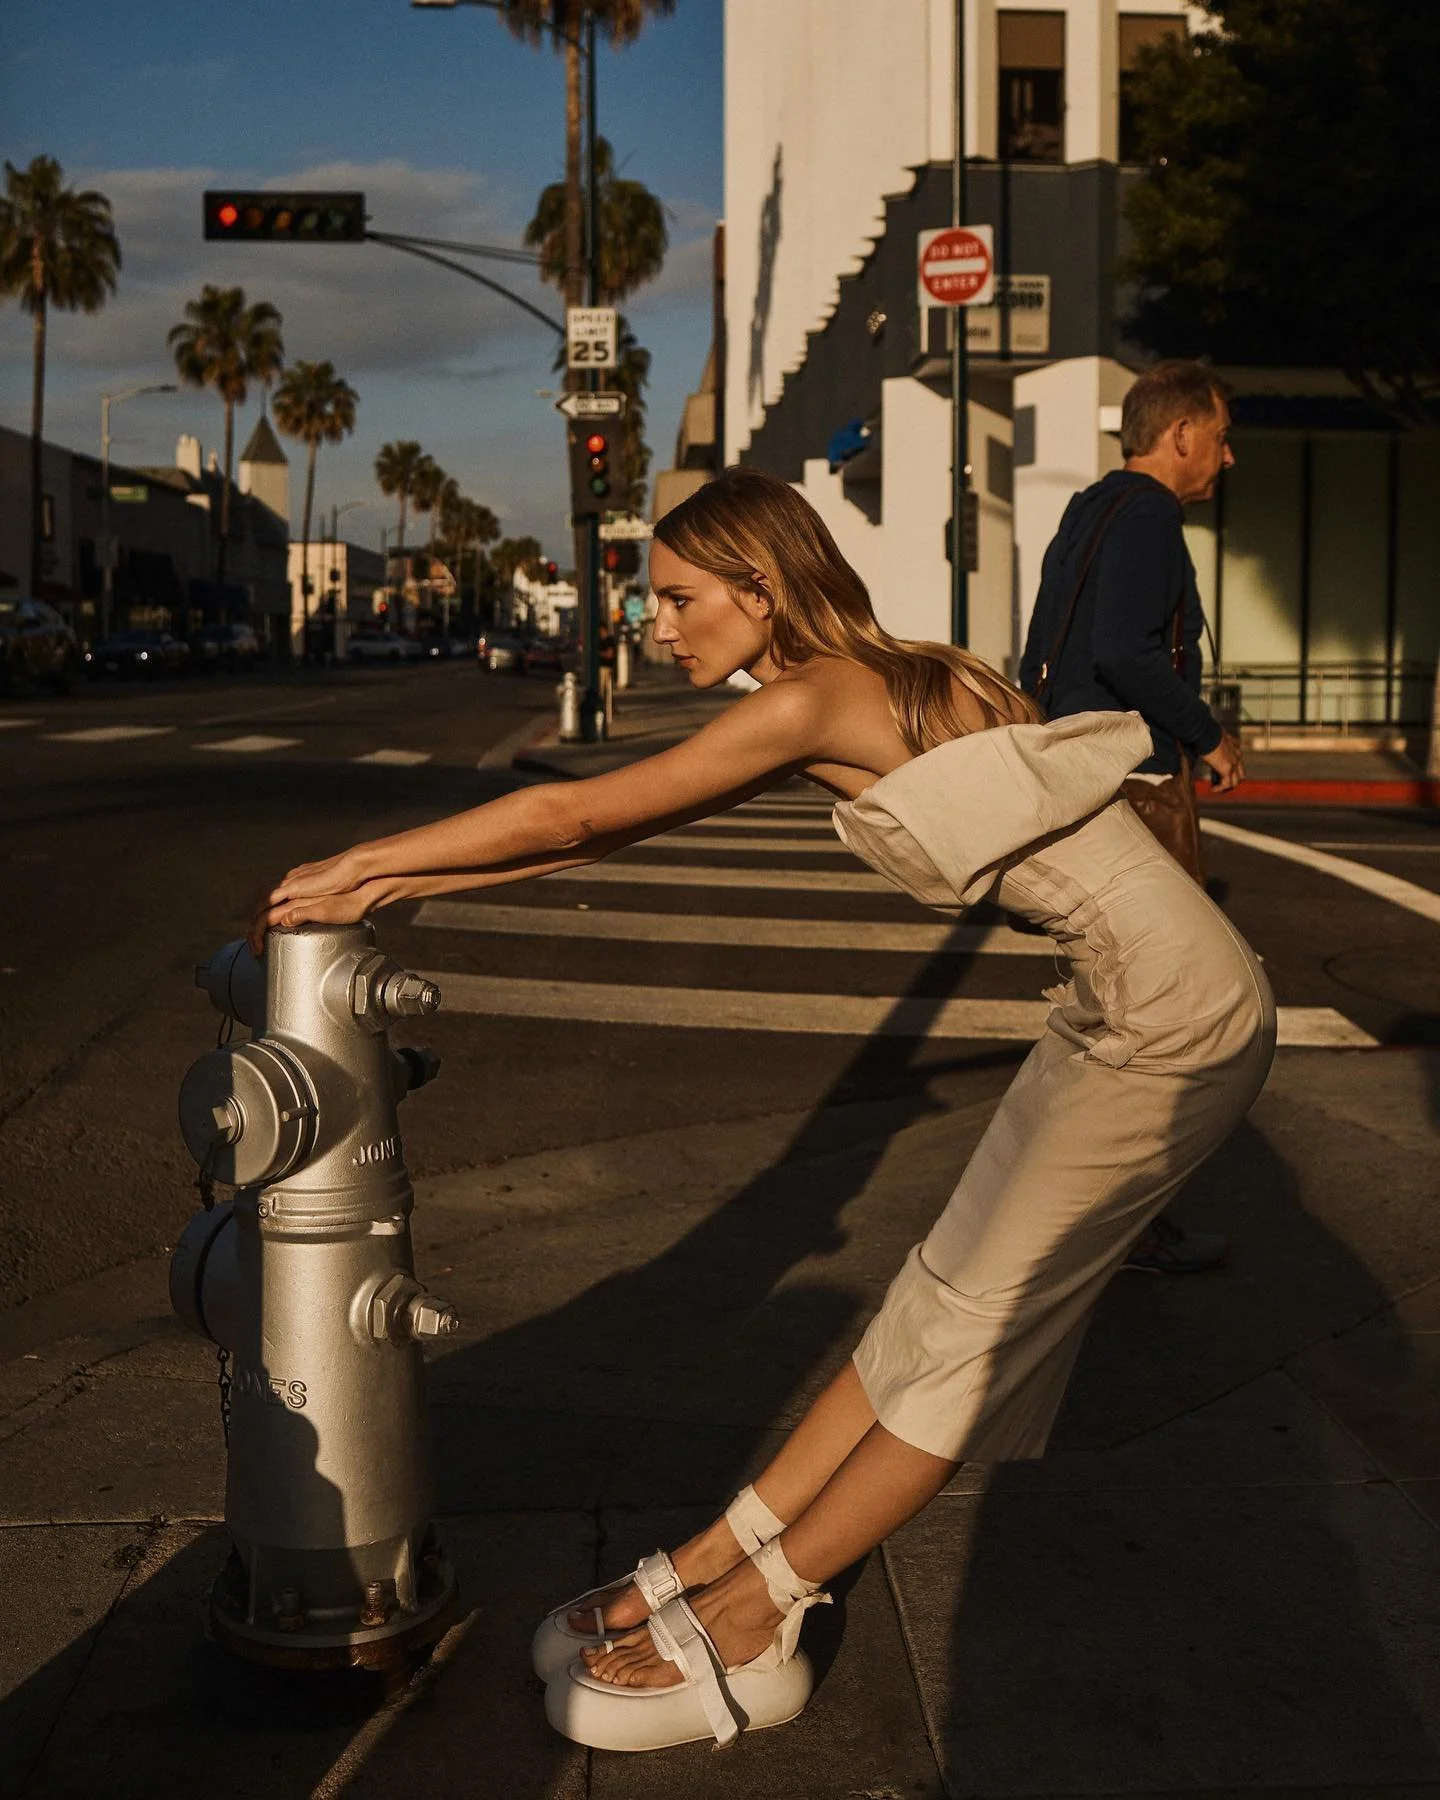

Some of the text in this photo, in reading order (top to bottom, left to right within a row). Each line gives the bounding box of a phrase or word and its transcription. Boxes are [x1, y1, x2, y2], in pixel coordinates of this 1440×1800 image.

[931, 241, 979, 258] DO NOT
[932, 275, 978, 292] ENTER
[573, 341, 609, 361] 25
[352, 1137, 397, 1167] JON
